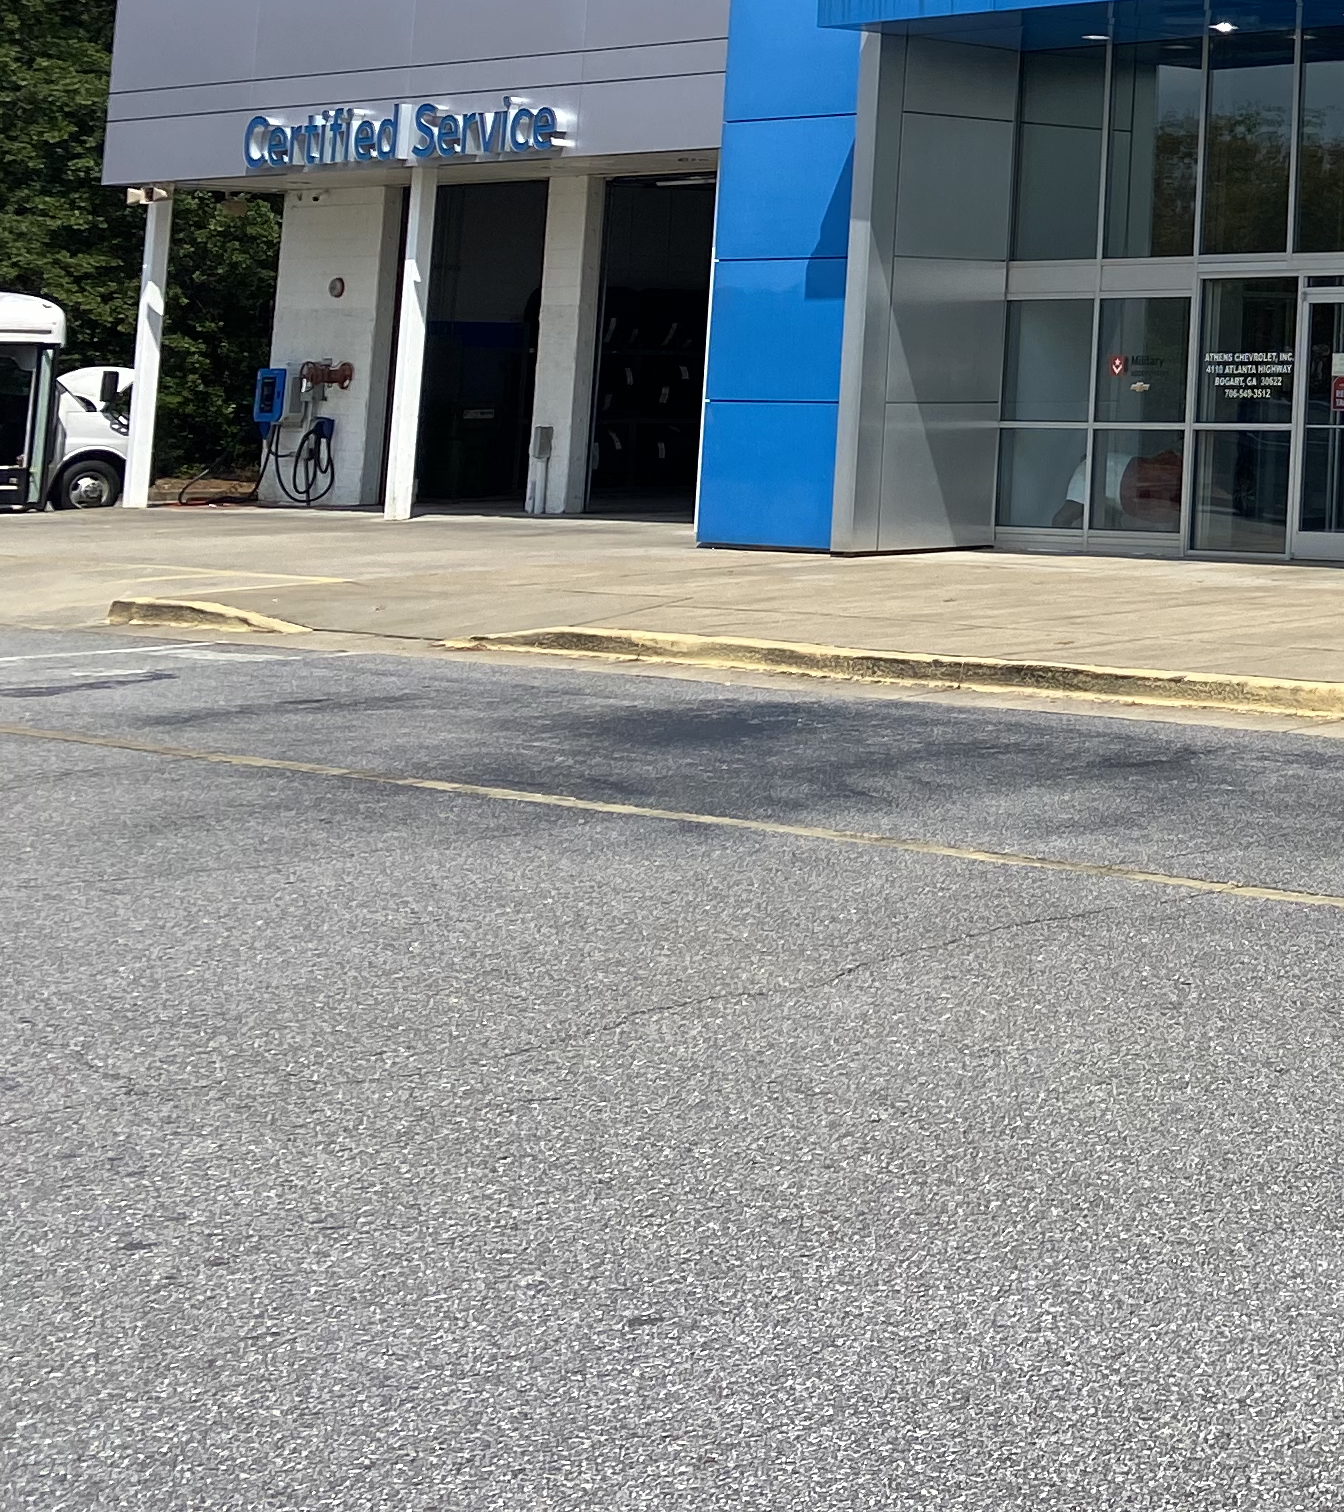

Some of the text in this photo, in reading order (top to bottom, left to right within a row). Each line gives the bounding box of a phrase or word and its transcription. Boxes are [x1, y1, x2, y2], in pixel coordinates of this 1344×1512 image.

[244, 95, 557, 169] Certified Service
[1131, 355, 1165, 368] Military
[1204, 352, 1233, 362] ATHENS
[1233, 352, 1278, 363] CHEVROLET,
[1224, 364, 1256, 374] ATLANTA
[1257, 364, 1292, 374] HIGHWAY
[1246, 376, 1257, 386] GA
